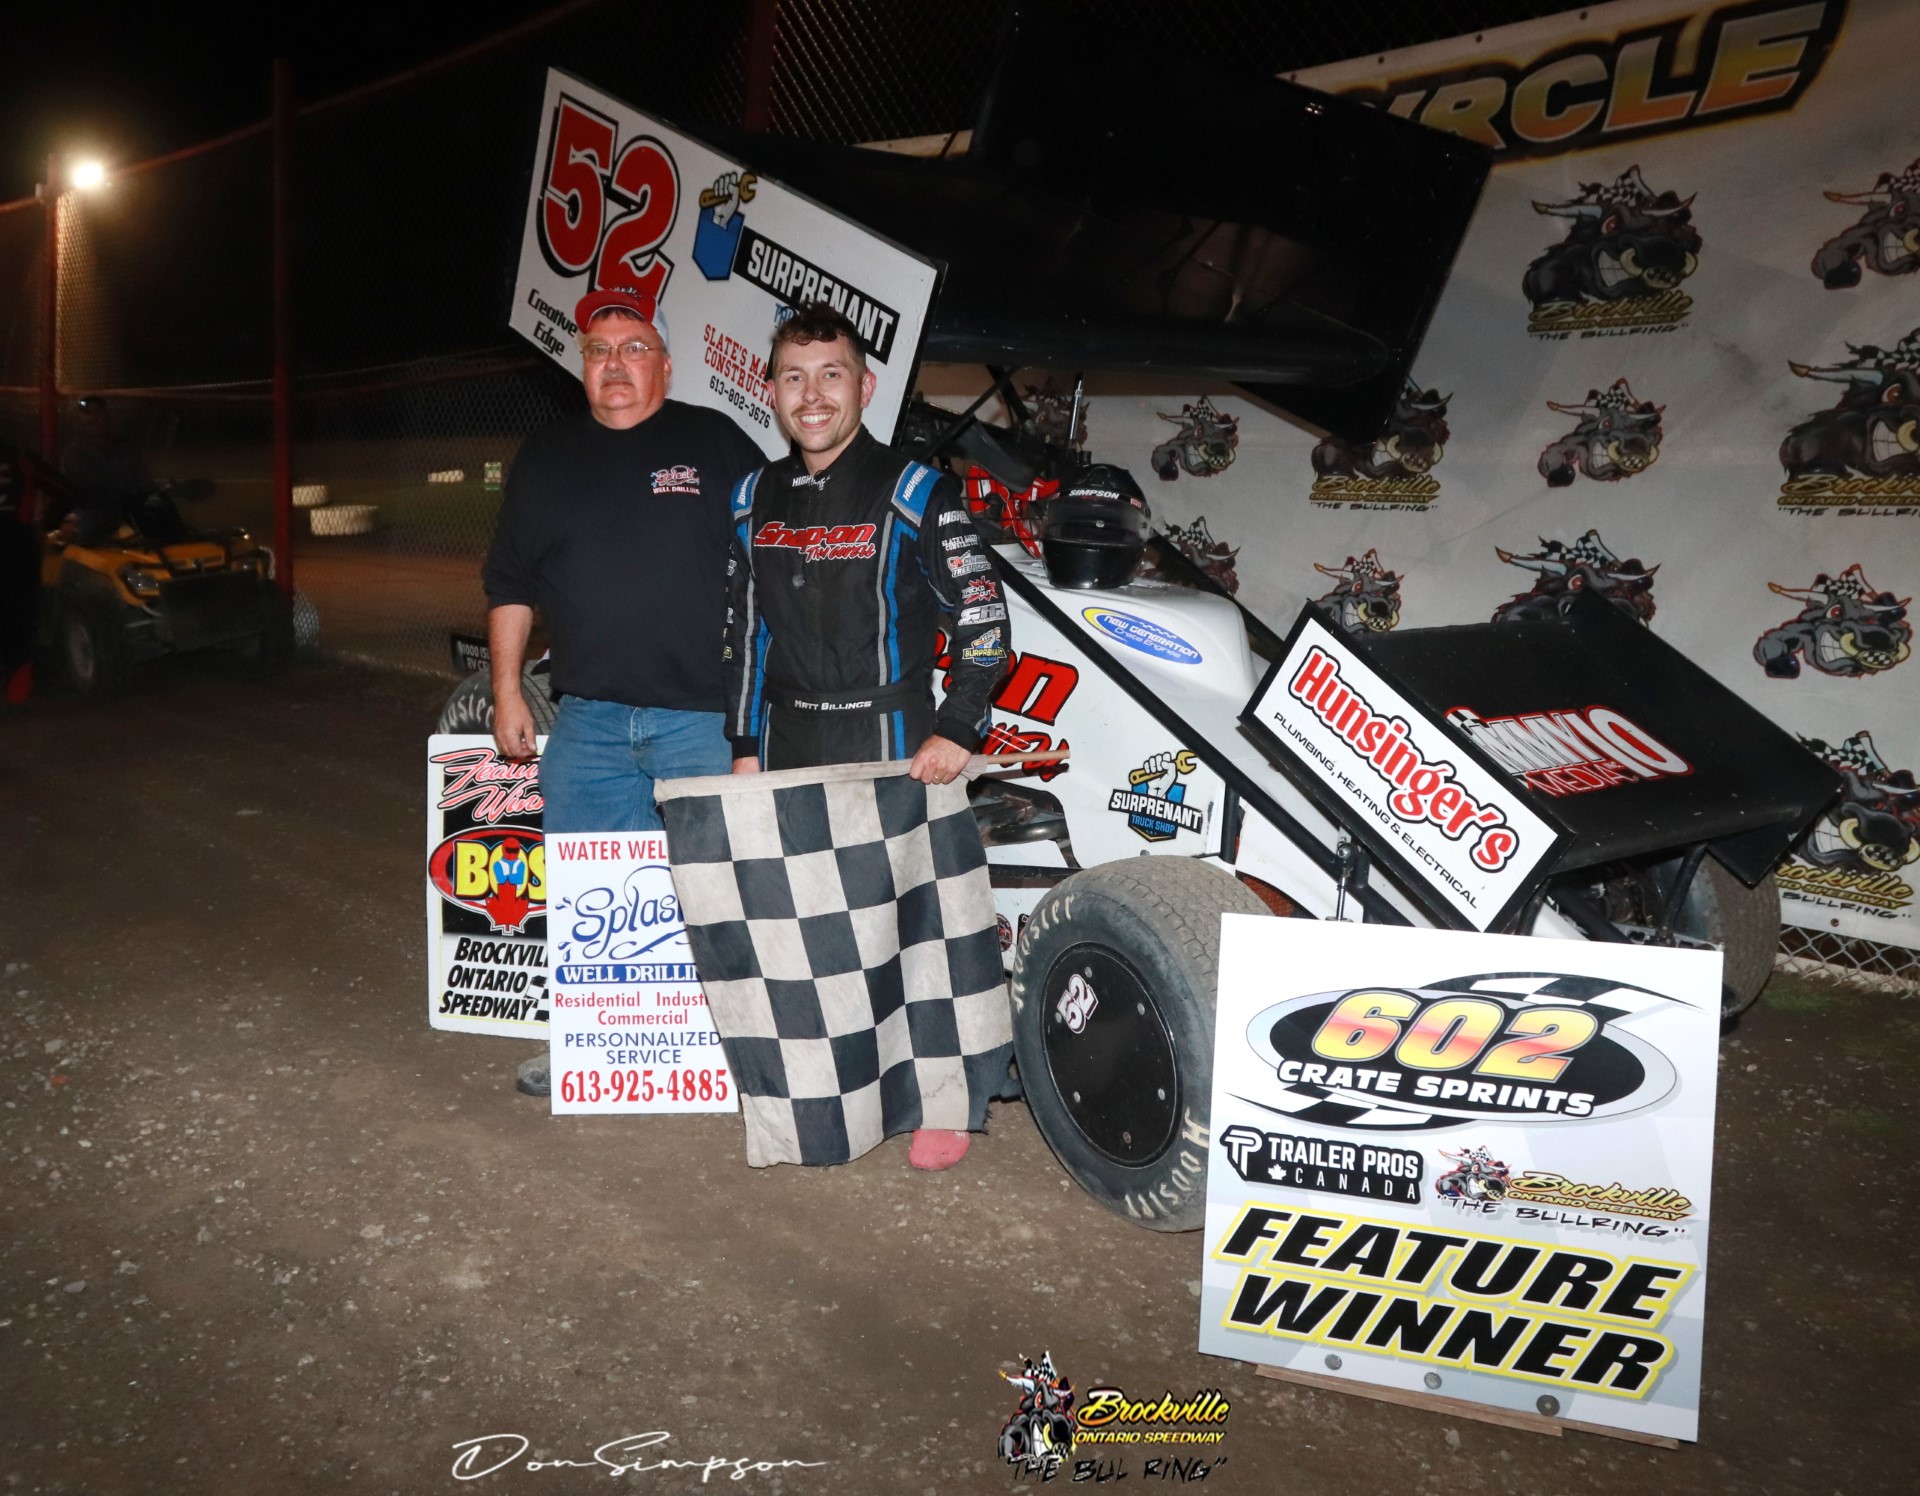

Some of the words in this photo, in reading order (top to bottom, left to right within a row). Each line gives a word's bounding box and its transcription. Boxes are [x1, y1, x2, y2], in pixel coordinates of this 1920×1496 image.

[1387, 2, 1826, 150] RCLE
[540, 94, 680, 302] 52
[747, 238, 895, 353] SURPRENANT
[1528, 289, 1694, 322] Brockville
[527, 288, 578, 338] Creative
[533, 320, 565, 357] Edge
[703, 323, 748, 368] SLATE'S
[749, 353, 767, 379] MA
[704, 346, 776, 411] CONSTRUCTI
[709, 374, 772, 429] 613-802-3676
[653, 486, 671, 495] WELL
[671, 485, 701, 495] DRILLING
[1068, 488, 1120, 500] SIMPSON
[1311, 475, 1441, 494] Brockville
[754, 521, 877, 555] Snap-on
[1114, 627, 1143, 643] Crate
[467, 657, 477, 669] RV
[795, 700, 819, 711] MATT
[821, 700, 873, 711] BILLINGS
[1291, 649, 1516, 869] Hunsinger's
[1110, 791, 1202, 830] SURPRENANT
[1131, 814, 1154, 829] TRUCK
[1155, 819, 1176, 834] SHOP
[1274, 712, 1336, 776] PLUMBING,
[1337, 771, 1392, 825] HEATING
[1390, 823, 1402, 836] &
[1401, 832, 1478, 909] ELECTRICAL
[558, 841, 621, 860] WATER
[628, 840, 667, 860] WEL
[455, 841, 546, 900] BOS
[1775, 864, 1914, 899] rockville
[1801, 883, 1902, 910] SPEEDWAY
[454, 936, 548, 968] BROCKVIL
[447, 965, 528, 993] ONTARIO
[562, 965, 619, 983] WELL
[625, 965, 698, 983] DRILLI
[439, 990, 533, 1021] SPEEDWAY
[555, 991, 641, 1008] Residential
[1057, 973, 1099, 1033] 52
[597, 1009, 688, 1025] Commercial
[564, 1031, 722, 1048] PERSONNALIZED
[1312, 990, 1598, 1081] 602
[606, 1050, 682, 1065] SERVICE
[561, 1069, 729, 1104] 613-925-4885
[1279, 1060, 1400, 1093] CRATE
[1414, 1077, 1595, 1117] SPRINTS
[1268, 1136, 1355, 1171] TRAILER
[1363, 1149, 1419, 1179] PROS
[1295, 1167, 1416, 1200] CANADA
[1510, 1171, 1692, 1213] Brockville
[1507, 1190, 1585, 1208] ONTARIO
[1585, 1201, 1688, 1221] SPEEDWAY
[1221, 1206, 1683, 1321] FEATURE
[1229, 1273, 1669, 1391] WINNER
